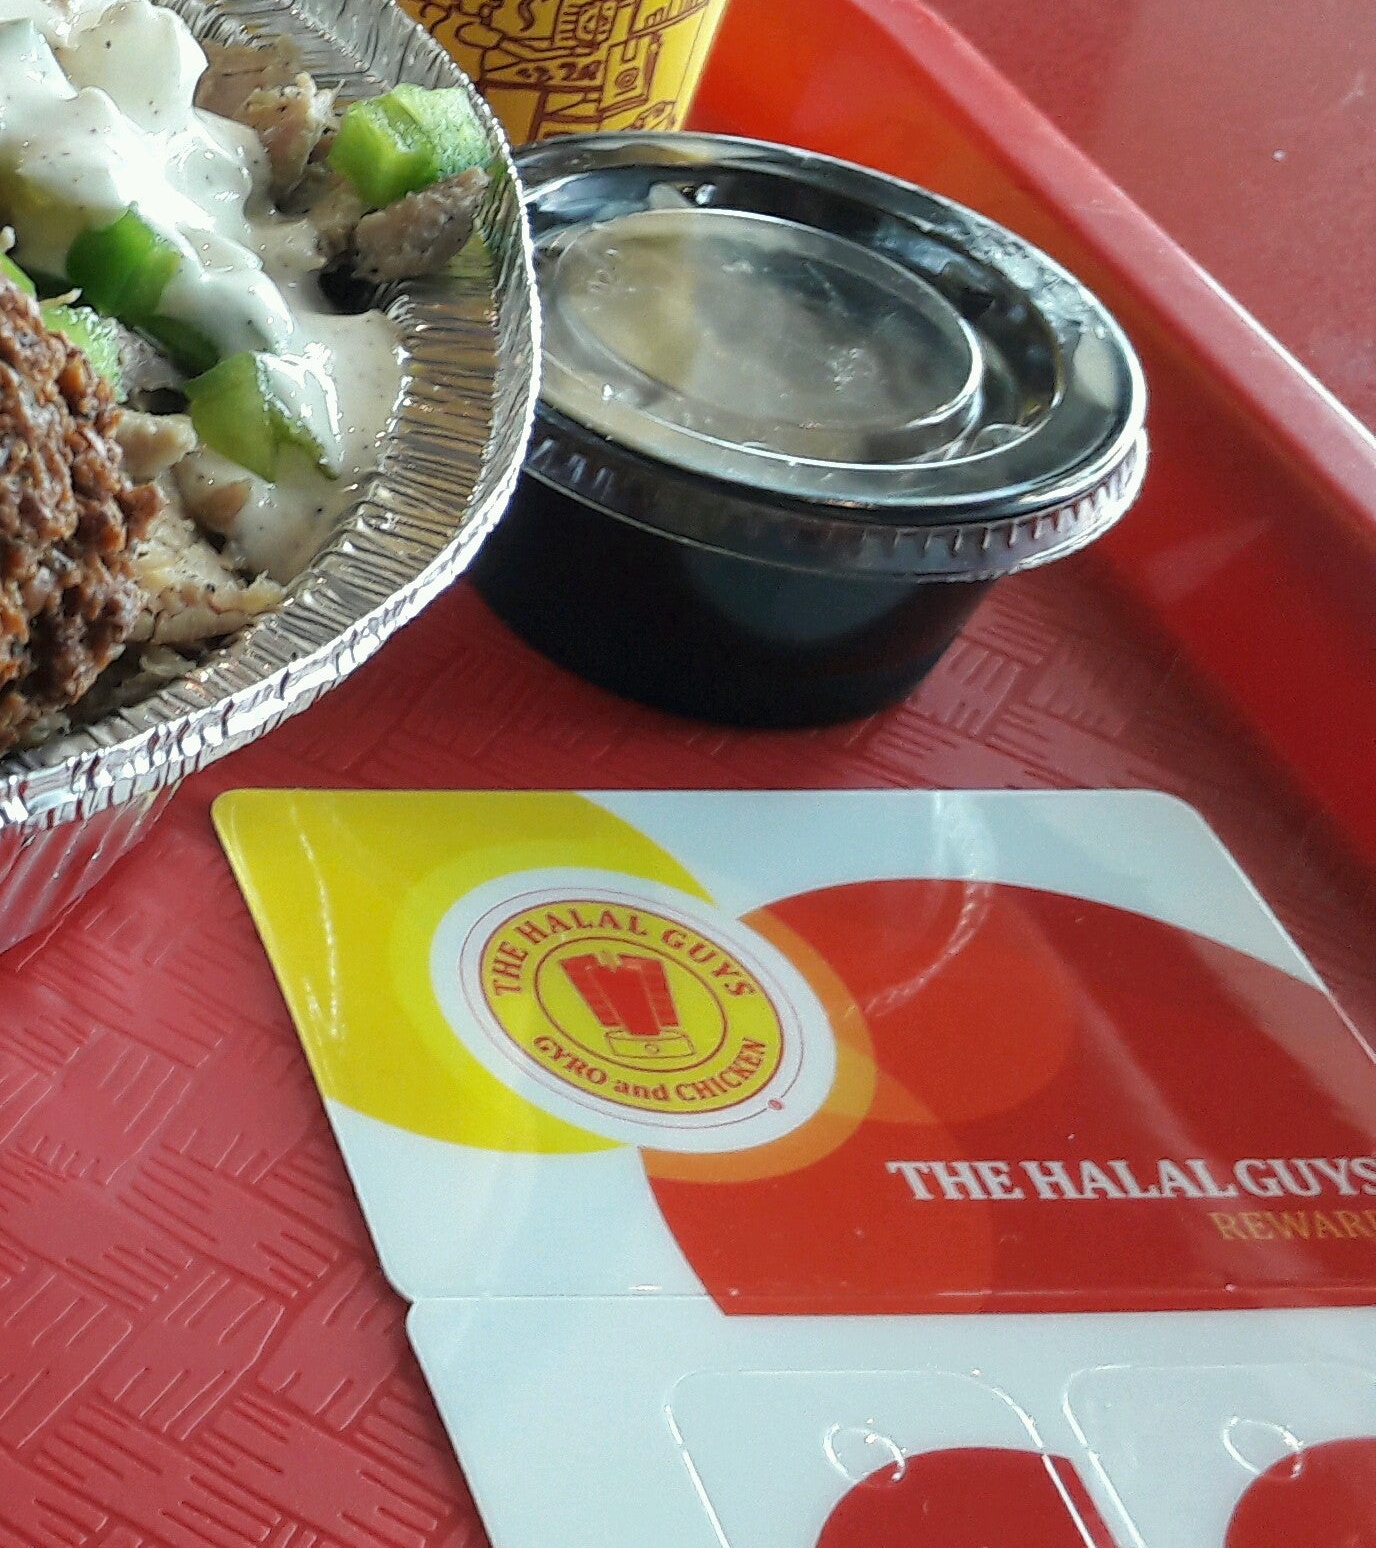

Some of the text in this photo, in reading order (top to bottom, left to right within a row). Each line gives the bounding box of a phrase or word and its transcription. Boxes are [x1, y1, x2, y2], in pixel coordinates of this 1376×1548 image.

[492, 907, 756, 998] THE HALAL GUYS
[533, 1035, 766, 1102] GYRO and CHICKEN
[885, 1158, 1026, 1201] THE
[1018, 1157, 1240, 1200] HALAL
